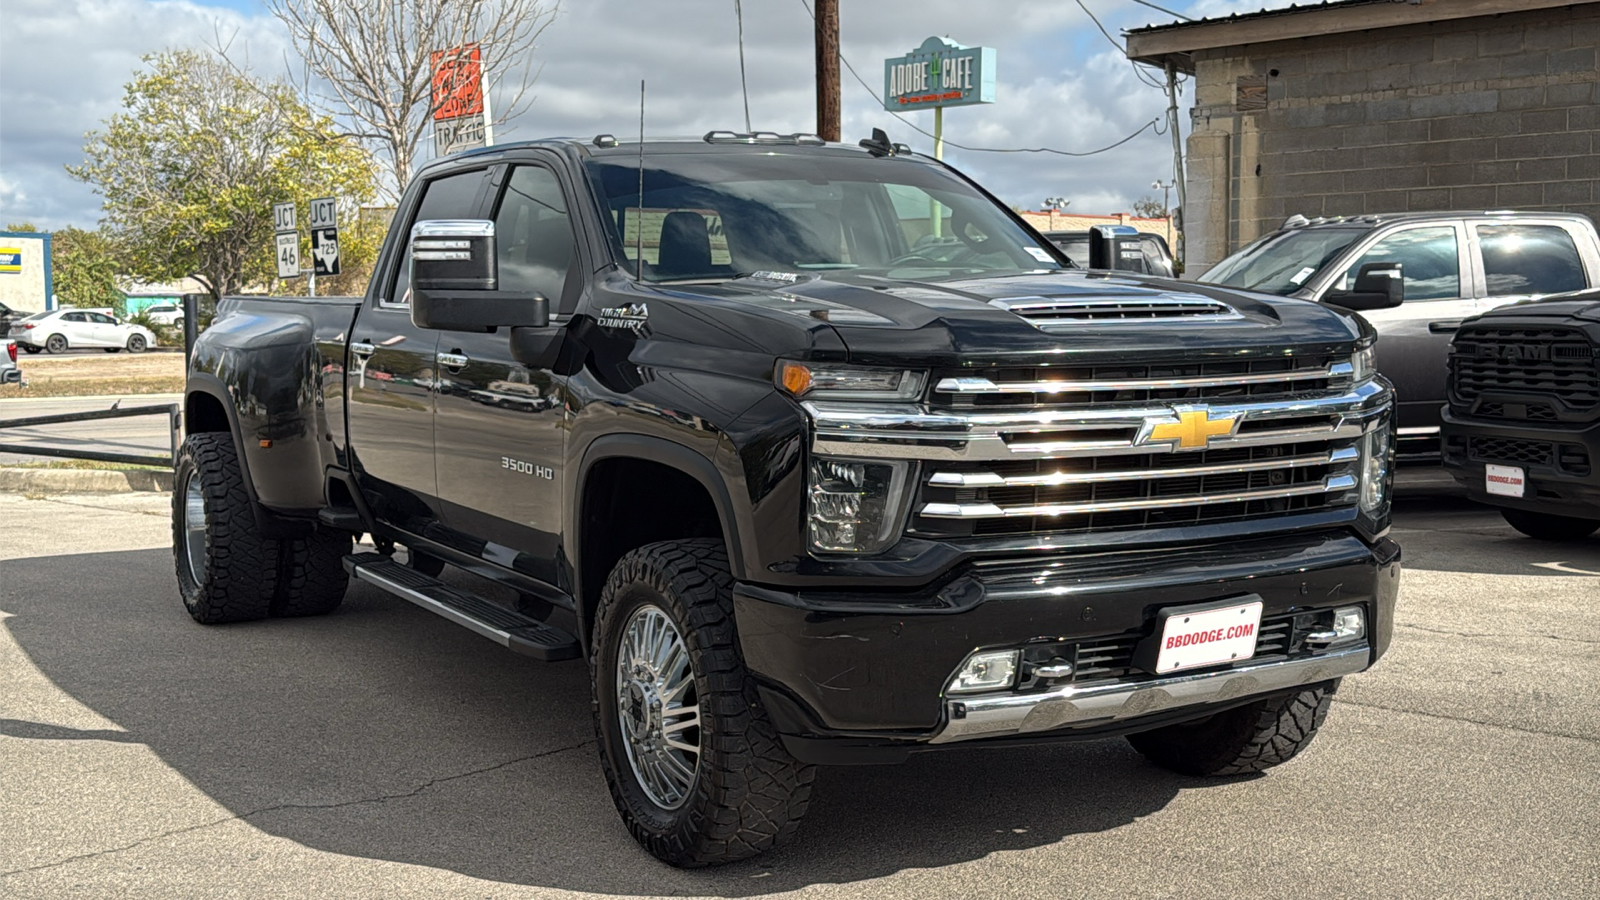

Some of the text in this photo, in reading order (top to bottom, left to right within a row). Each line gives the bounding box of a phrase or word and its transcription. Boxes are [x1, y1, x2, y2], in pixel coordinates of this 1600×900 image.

[889, 62, 929, 97] ADOBE
[942, 56, 974, 90] CAFE
[276, 207, 294, 227] JCT
[312, 202, 334, 223] JCT
[281, 247, 296, 266] 46
[320, 243, 336, 255] 725
[597, 317, 646, 330] COUNTRY
[1478, 343, 1549, 360] RAM
[501, 456, 553, 480] 3500 HD
[1165, 623, 1254, 650] BBDODGE.COM
